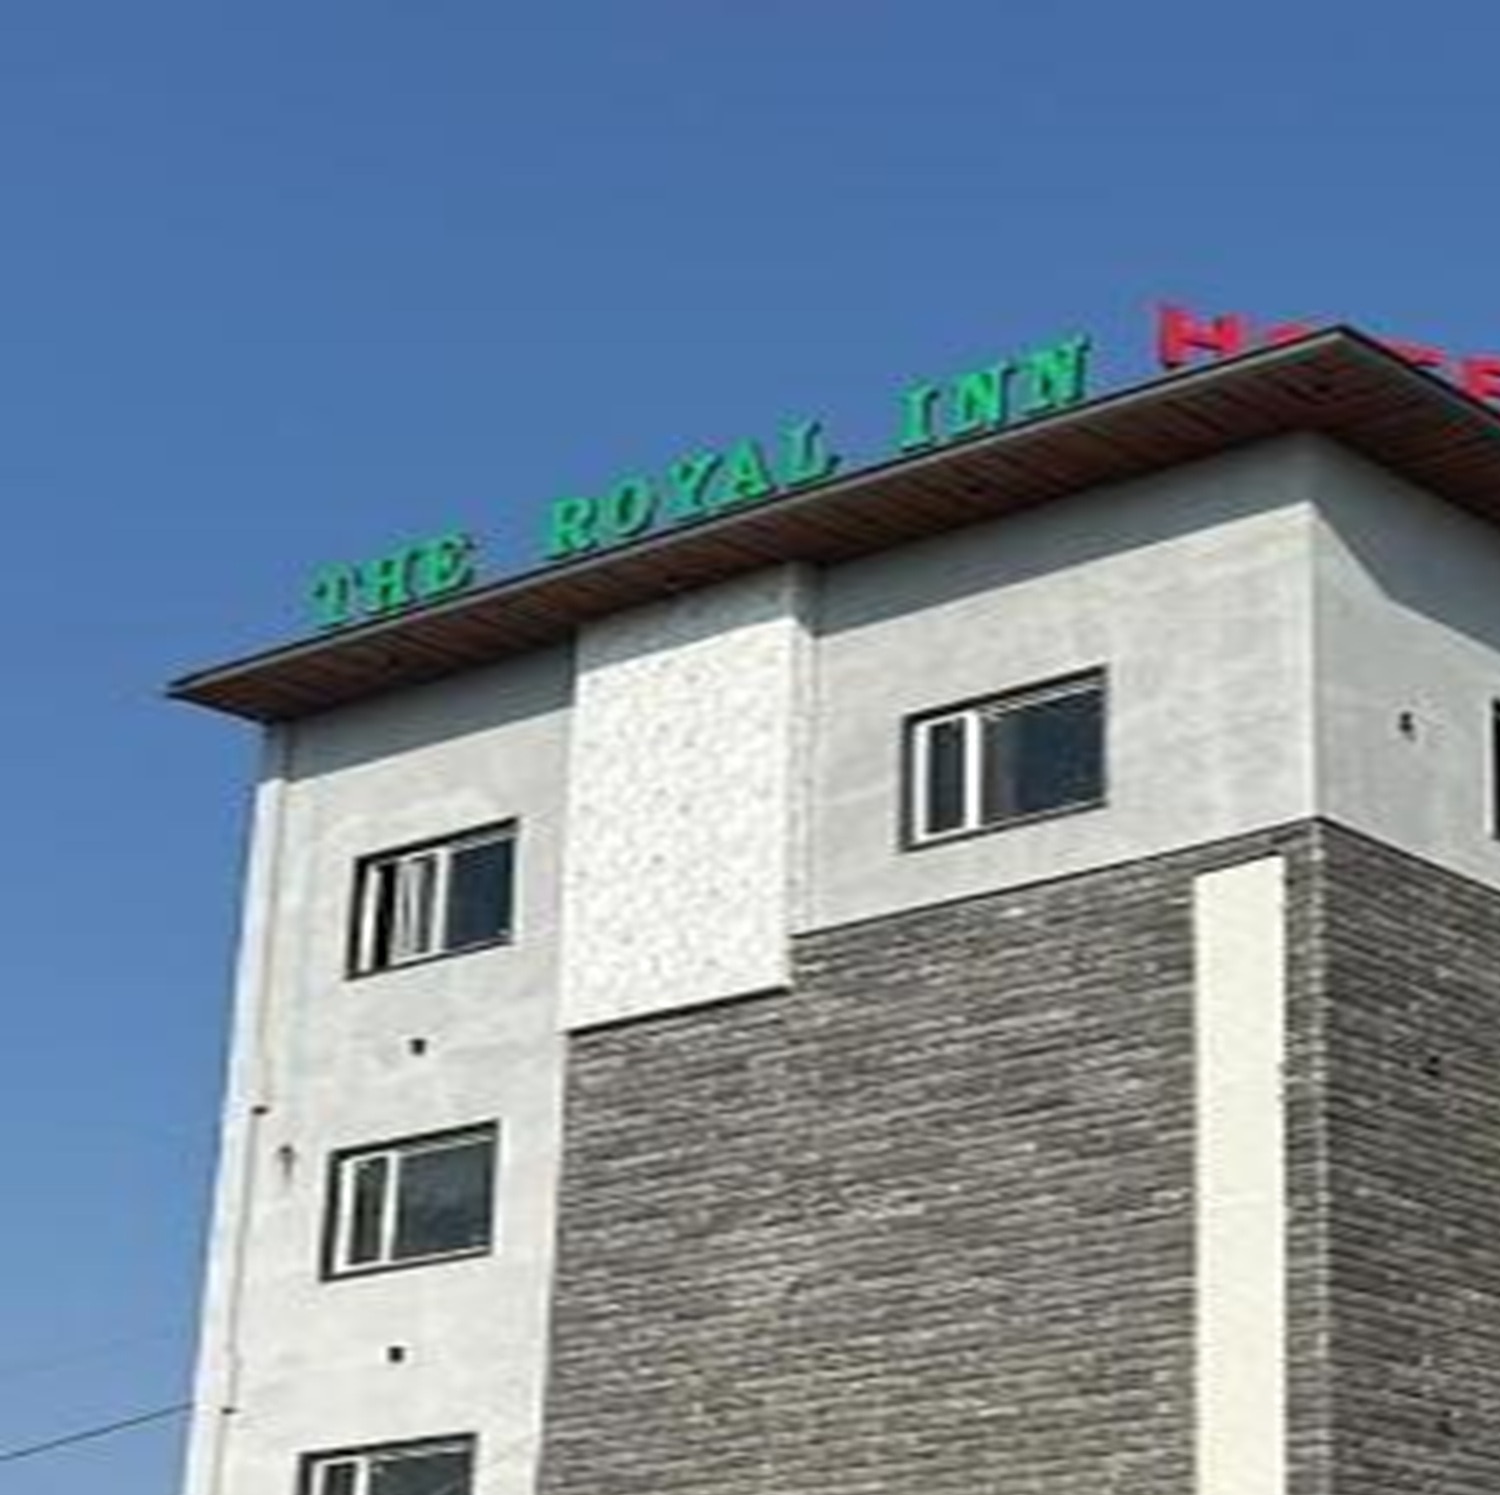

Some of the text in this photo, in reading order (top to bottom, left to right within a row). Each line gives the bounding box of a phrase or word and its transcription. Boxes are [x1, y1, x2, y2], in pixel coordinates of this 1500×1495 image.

[310, 335, 1091, 628] THE ROYAL INN
